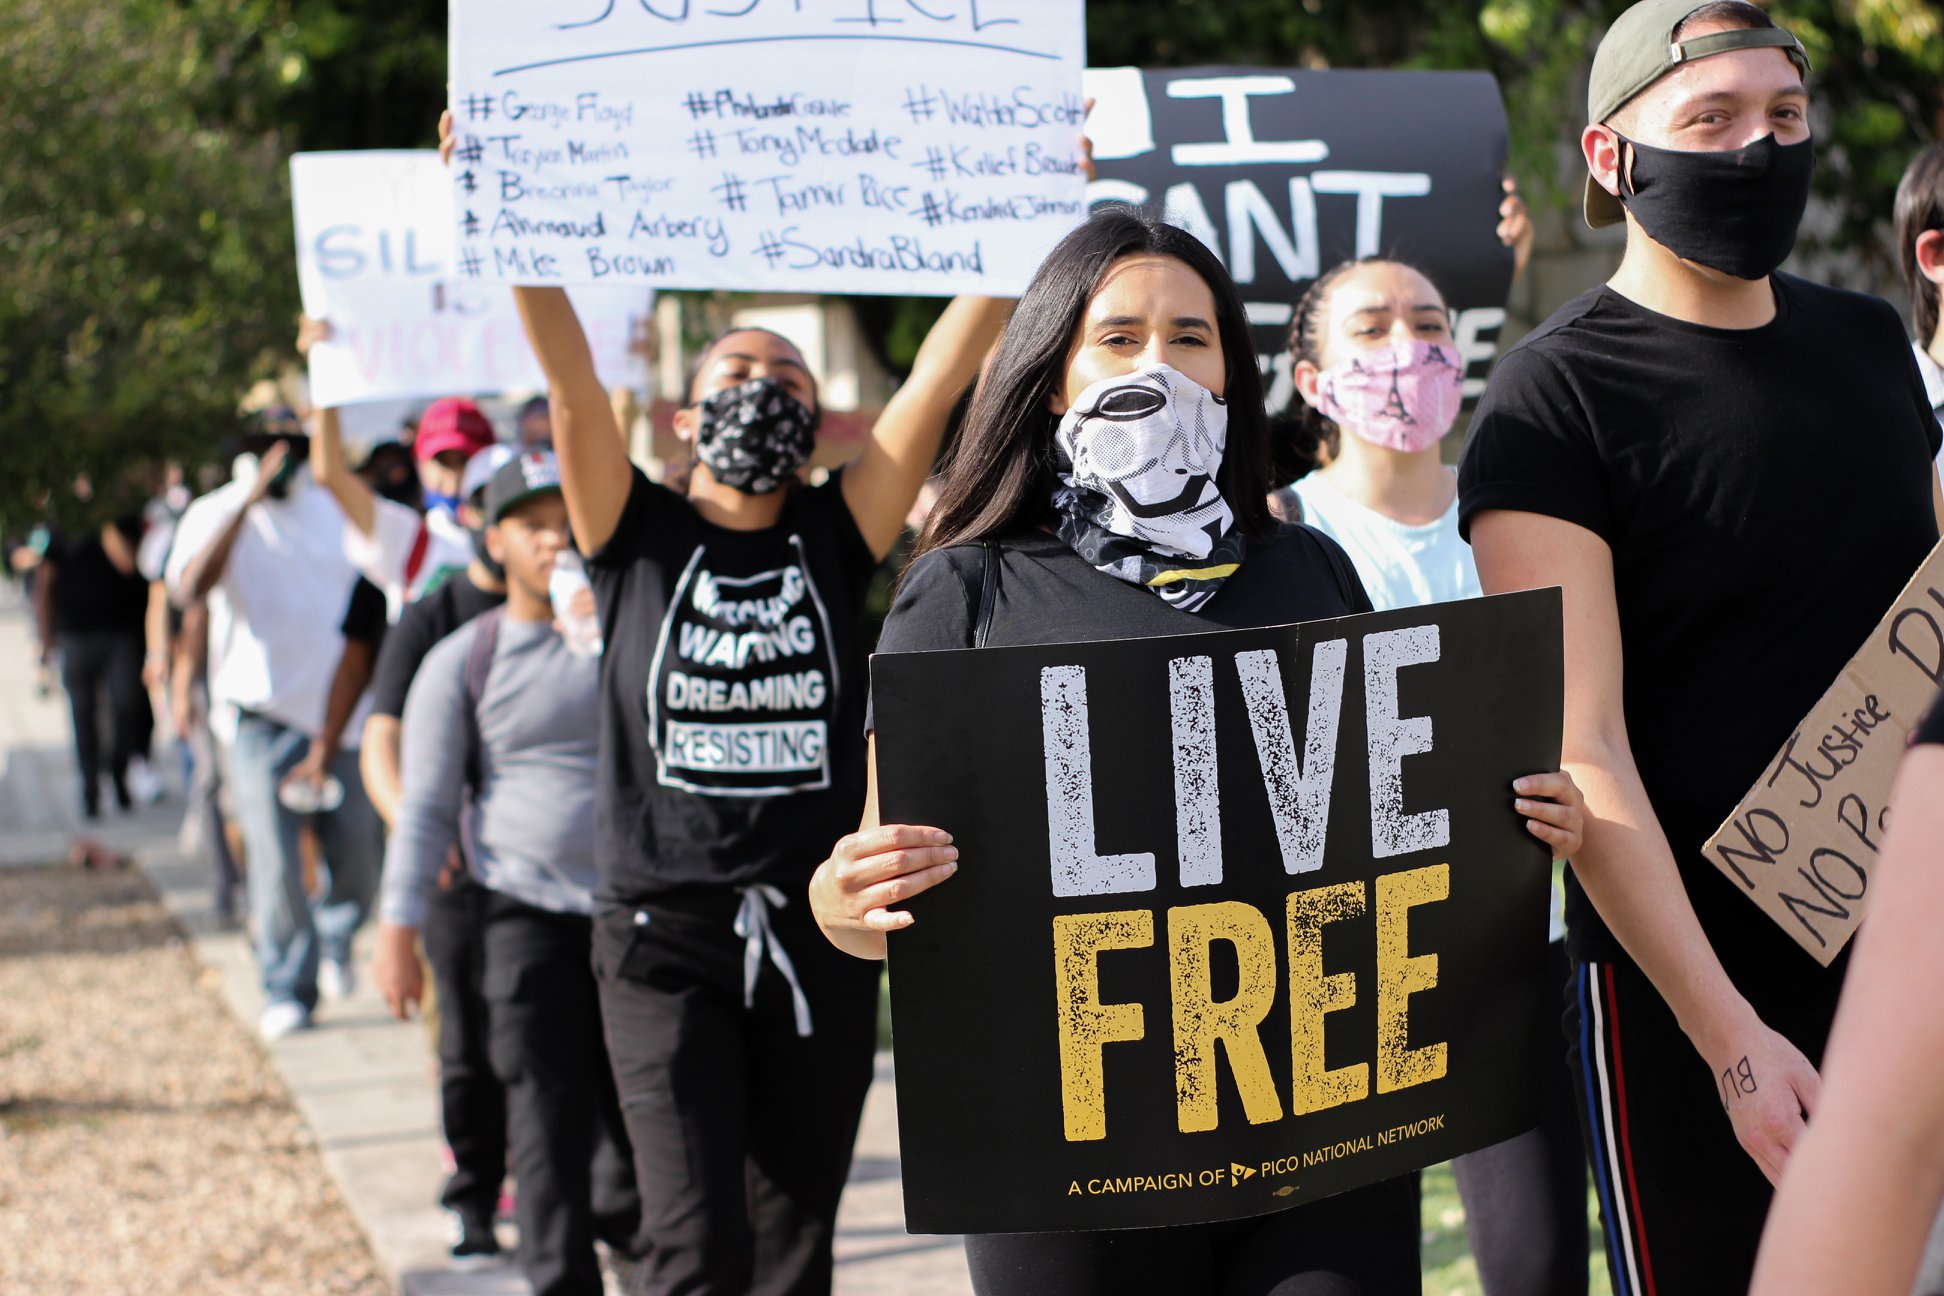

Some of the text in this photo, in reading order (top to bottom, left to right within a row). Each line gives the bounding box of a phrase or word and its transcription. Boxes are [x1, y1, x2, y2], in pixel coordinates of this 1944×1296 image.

[1166, 75, 1329, 166] I
[586, 246, 676, 278] Brown
[629, 209, 729, 257] Arbery
[665, 669, 827, 712] DREAMING
[671, 727, 823, 766] RESISTING
[1039, 623, 1450, 898] LIVE
[1716, 693, 1892, 891] NO Justice
[1777, 846, 1868, 949] NO
[1052, 862, 1450, 1142] FREE
[1067, 1113, 1445, 1196] A CAMPAIGN OF PICO NATIONAL NETWORK
